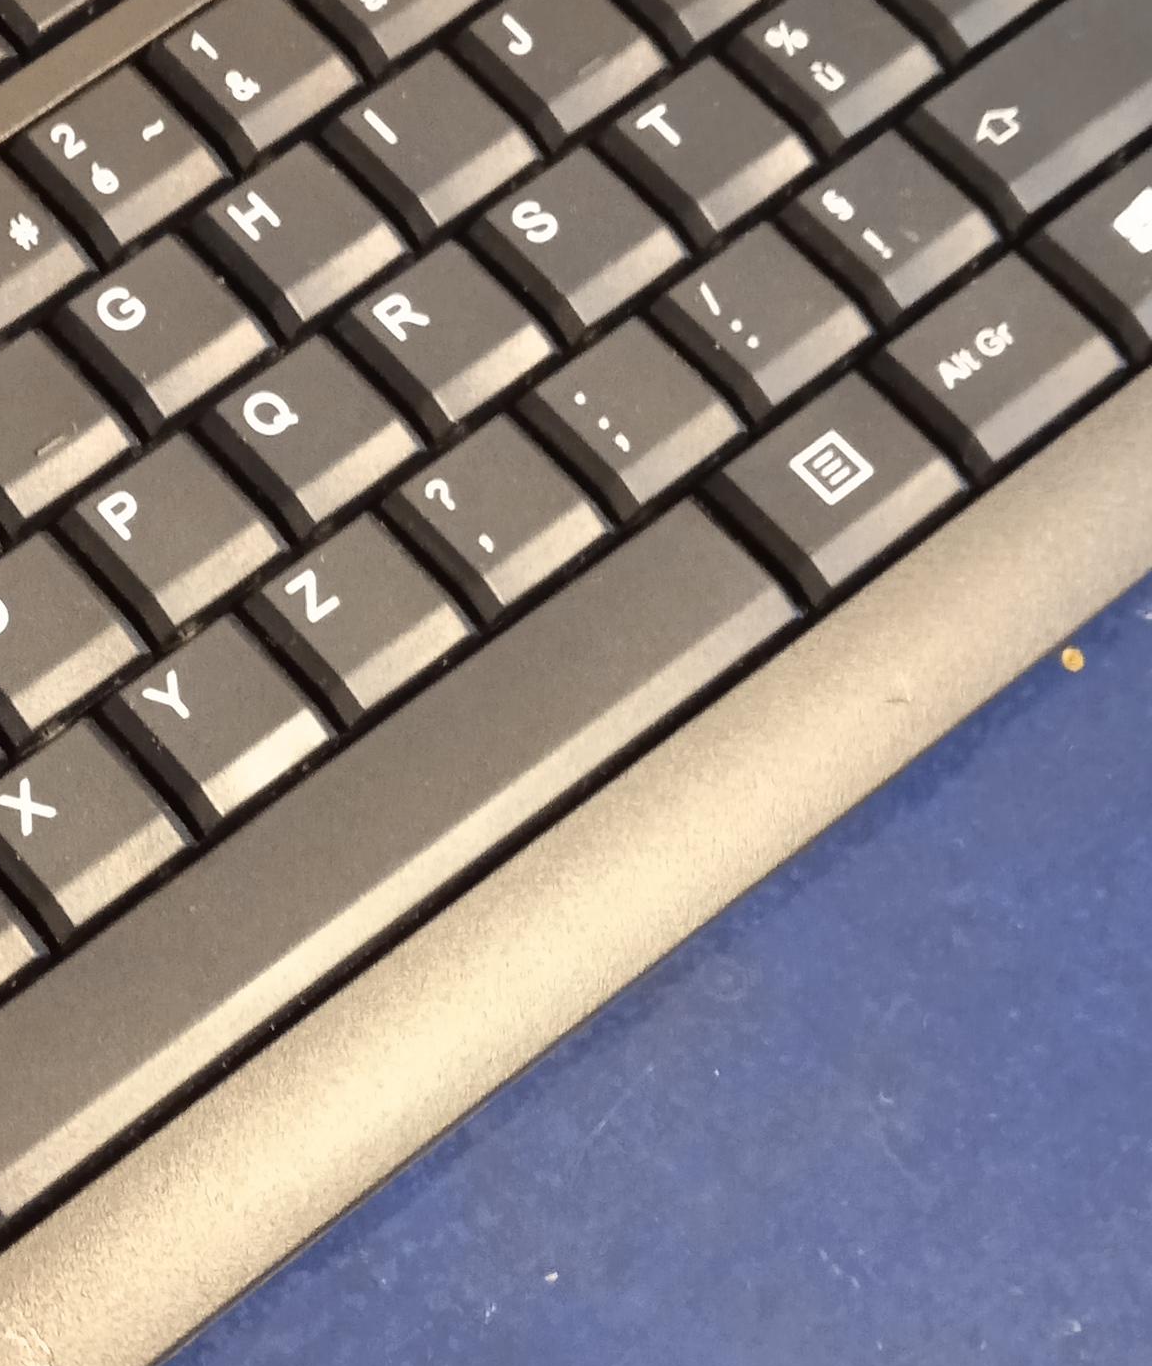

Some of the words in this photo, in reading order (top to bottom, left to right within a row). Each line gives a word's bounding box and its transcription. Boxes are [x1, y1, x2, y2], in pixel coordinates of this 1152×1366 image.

[190, 30, 219, 61] 1
[501, 13, 534, 56] J
[764, 20, 810, 57] %
[224, 69, 261, 102] &
[49, 122, 88, 160] 2
[362, 108, 399, 145] I
[635, 103, 682, 148] T
[226, 190, 282, 242] H
[511, 199, 559, 244] S
[96, 285, 147, 332] G
[371, 292, 431, 342] R
[936, 347, 983, 390] Alt
[973, 321, 1015, 358] Gr
[242, 390, 300, 436] Q
[96, 490, 138, 542] P
[424, 477, 457, 512] ?
[284, 568, 341, 624] Z
[141, 668, 191, 720] Y
